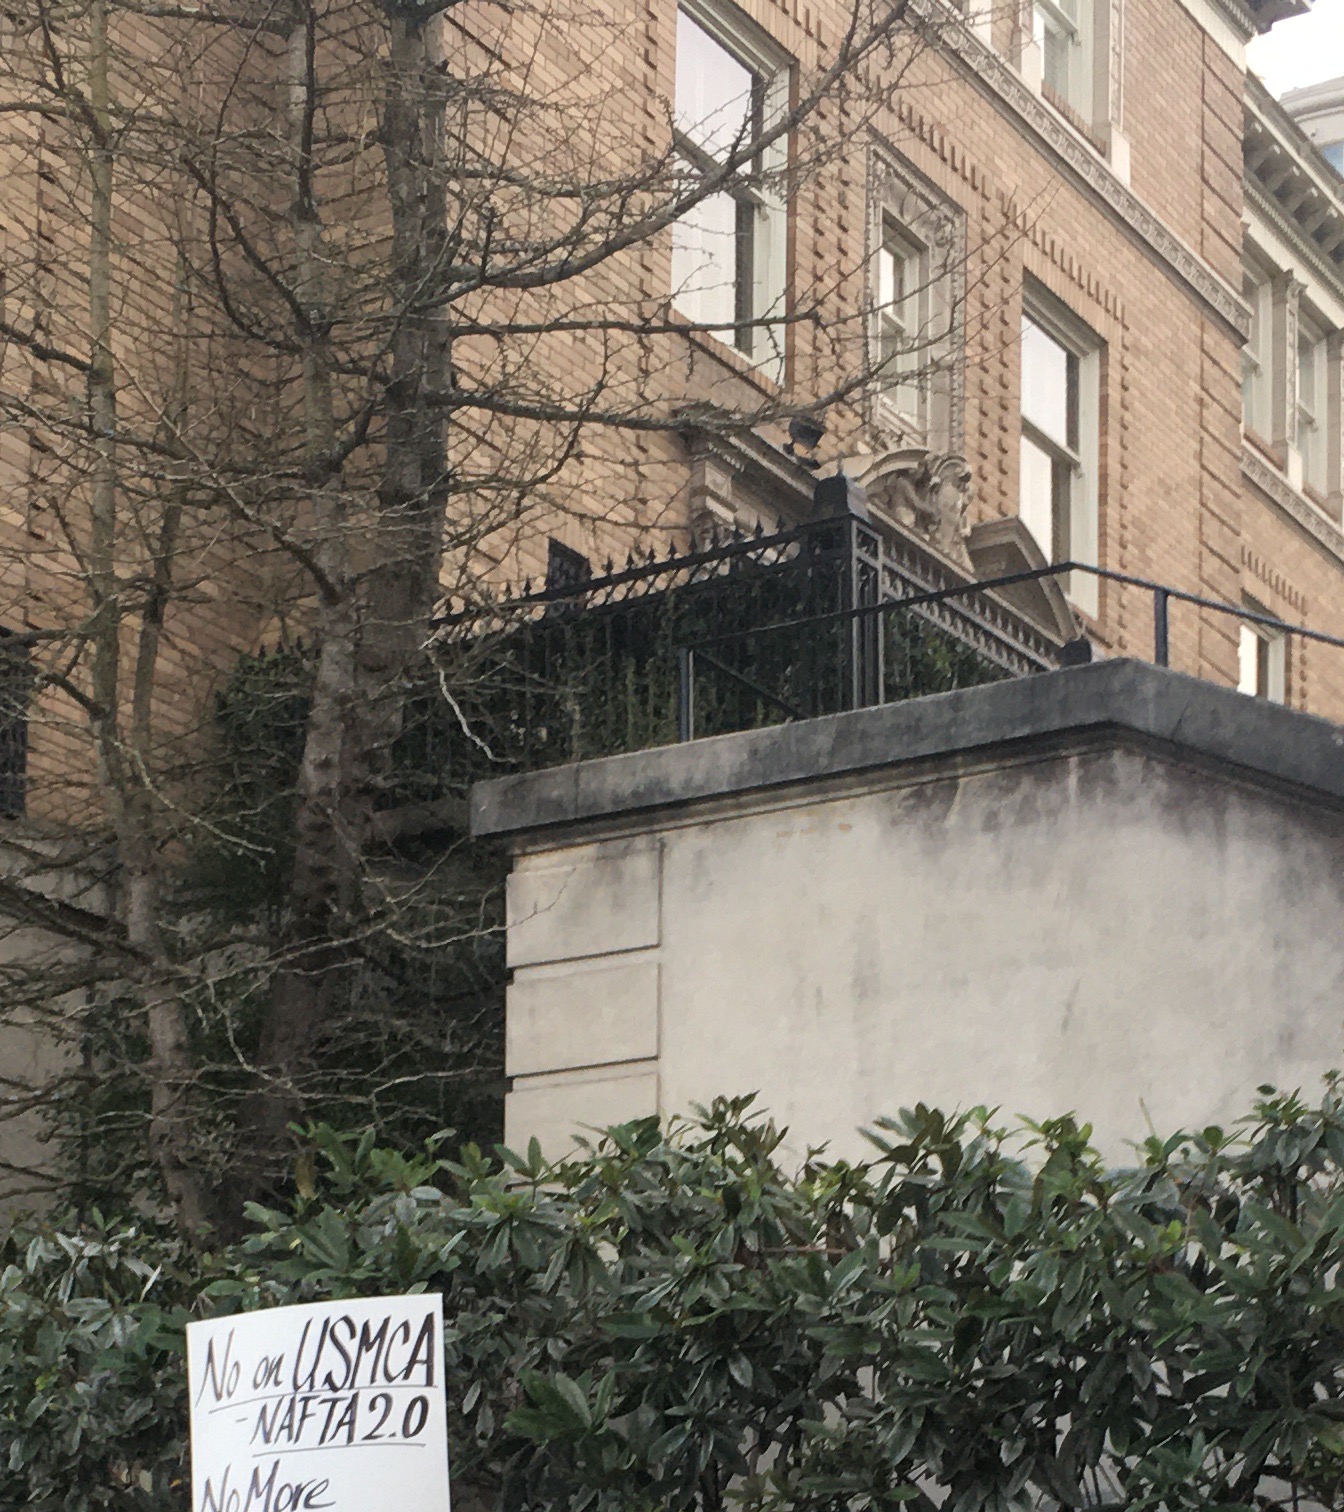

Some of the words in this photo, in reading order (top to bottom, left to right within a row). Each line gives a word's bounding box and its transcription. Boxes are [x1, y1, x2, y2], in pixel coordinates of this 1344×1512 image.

[195, 1328, 239, 1407] No
[253, 1352, 283, 1392] on
[292, 1312, 436, 1392] USMCA
[362, 1391, 429, 1441] 2.0
